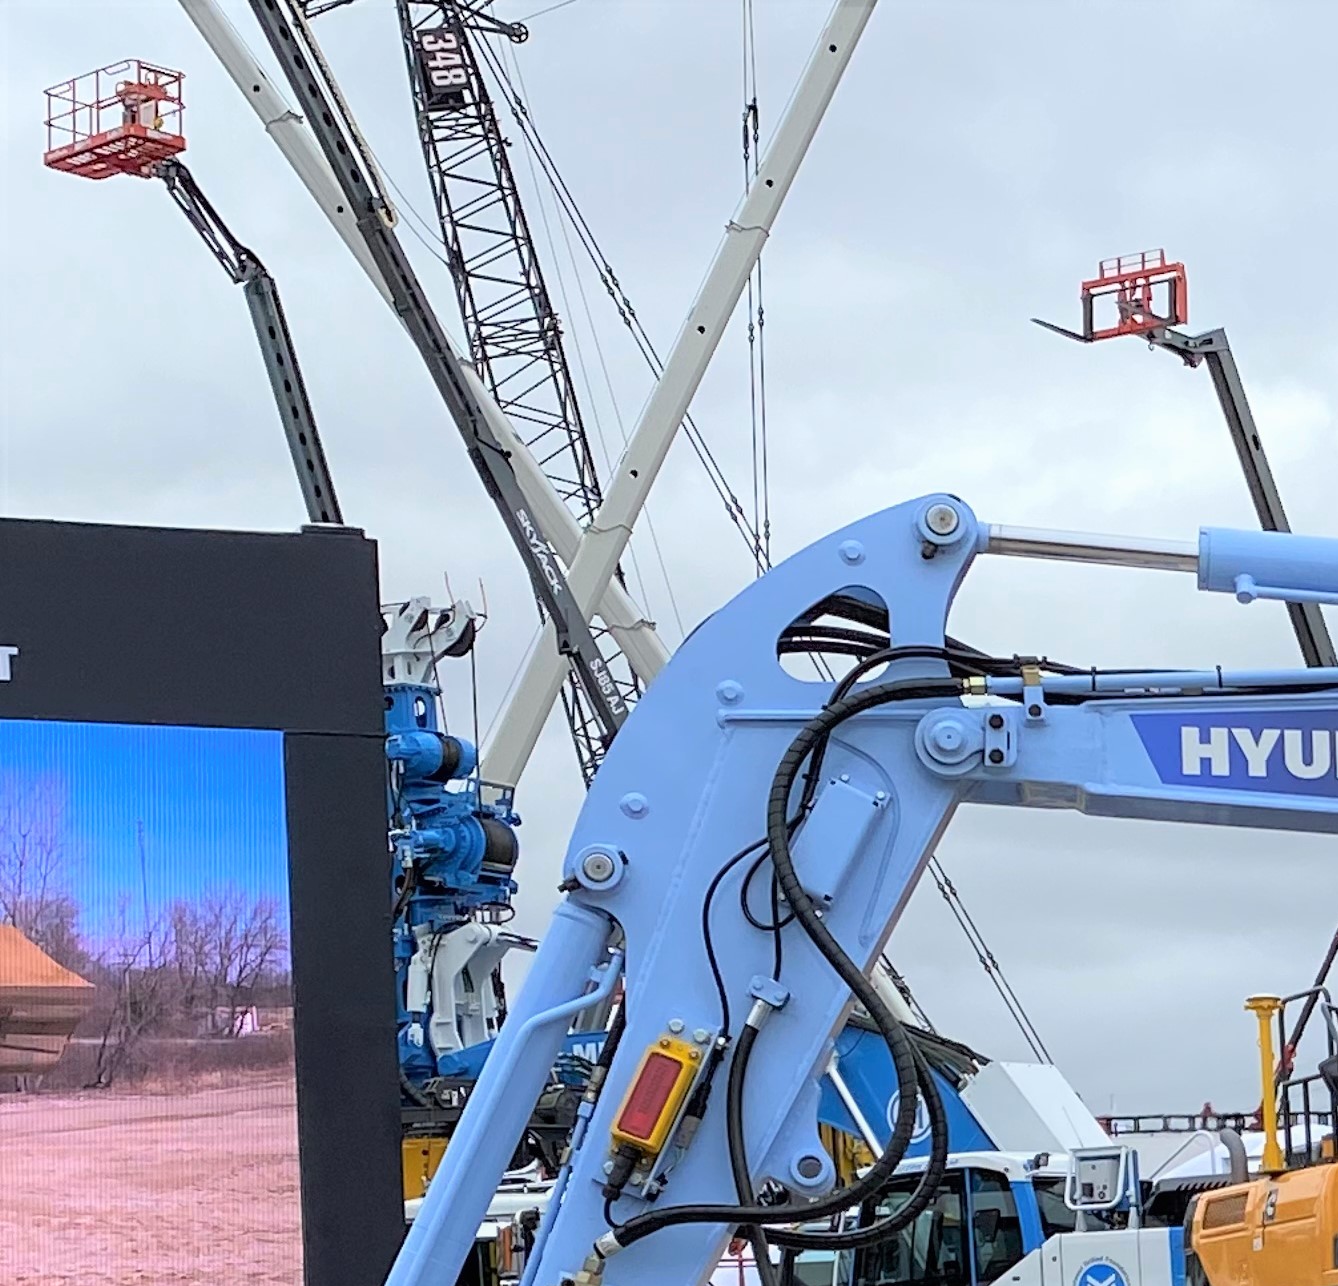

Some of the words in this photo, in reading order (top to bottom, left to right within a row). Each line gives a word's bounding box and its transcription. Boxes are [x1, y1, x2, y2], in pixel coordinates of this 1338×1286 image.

[422, 32, 468, 86] 348
[515, 509, 563, 596] SKYJACK
[589, 656, 614, 695] SJ85
[606, 694, 626, 716] AJ
